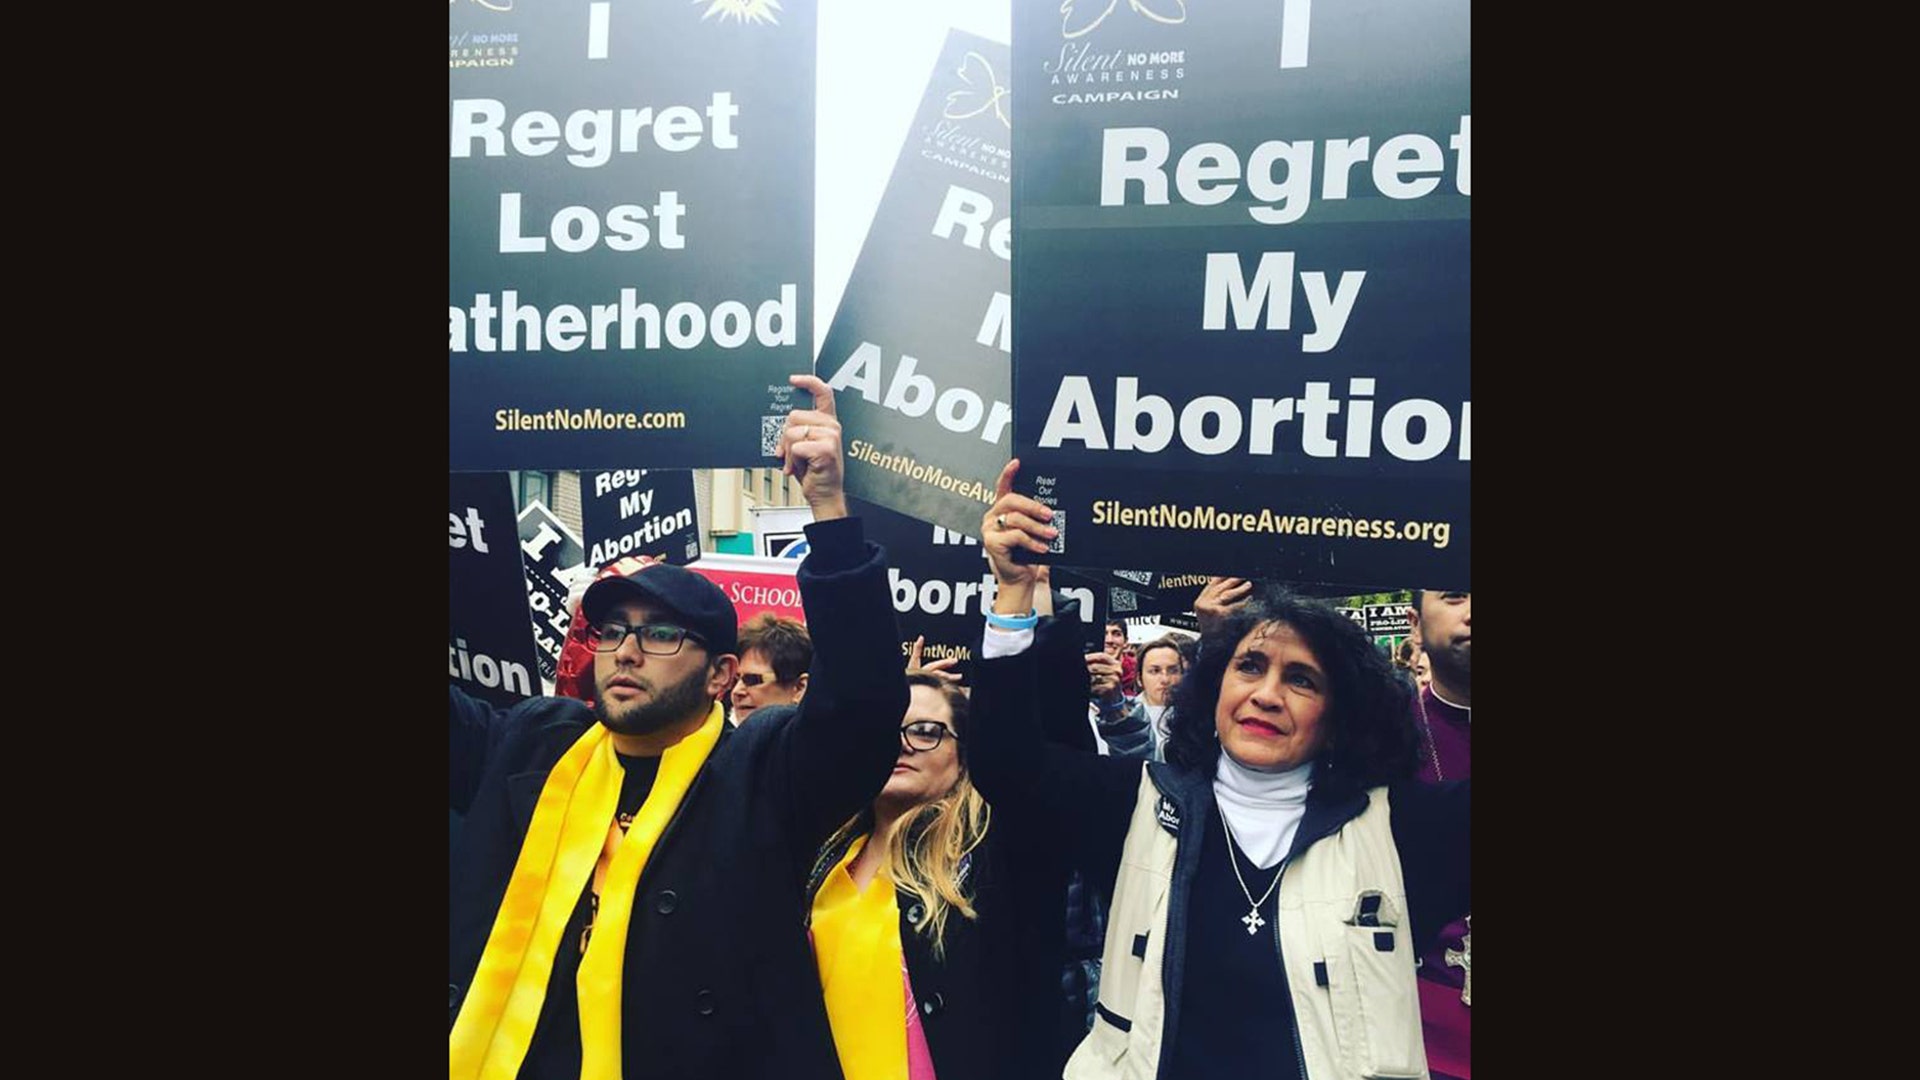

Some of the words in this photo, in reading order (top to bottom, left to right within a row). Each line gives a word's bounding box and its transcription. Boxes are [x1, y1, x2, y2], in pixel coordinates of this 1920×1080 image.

[490, 33, 518, 43] MORE
[588, 2, 610, 59] I
[1043, 42, 1122, 73] Silent
[1127, 53, 1147, 66] NO
[1150, 50, 1185, 65] MORE
[1280, 0, 1311, 69] I
[1051, 67, 1184, 85] AWARENESS
[1052, 89, 1179, 104] CAMPAIGN
[451, 92, 739, 168] Regret
[500, 191, 685, 253] Lost
[1203, 251, 1366, 353] My
[495, 409, 686, 431] SilentNoMore.com
[1038, 375, 1471, 462] Abortio
[619, 488, 655, 520] My
[1092, 500, 1451, 548] SilentNoMoreAwareness.org
[588, 507, 693, 569] Abortion
[888, 568, 1094, 623] bortn
